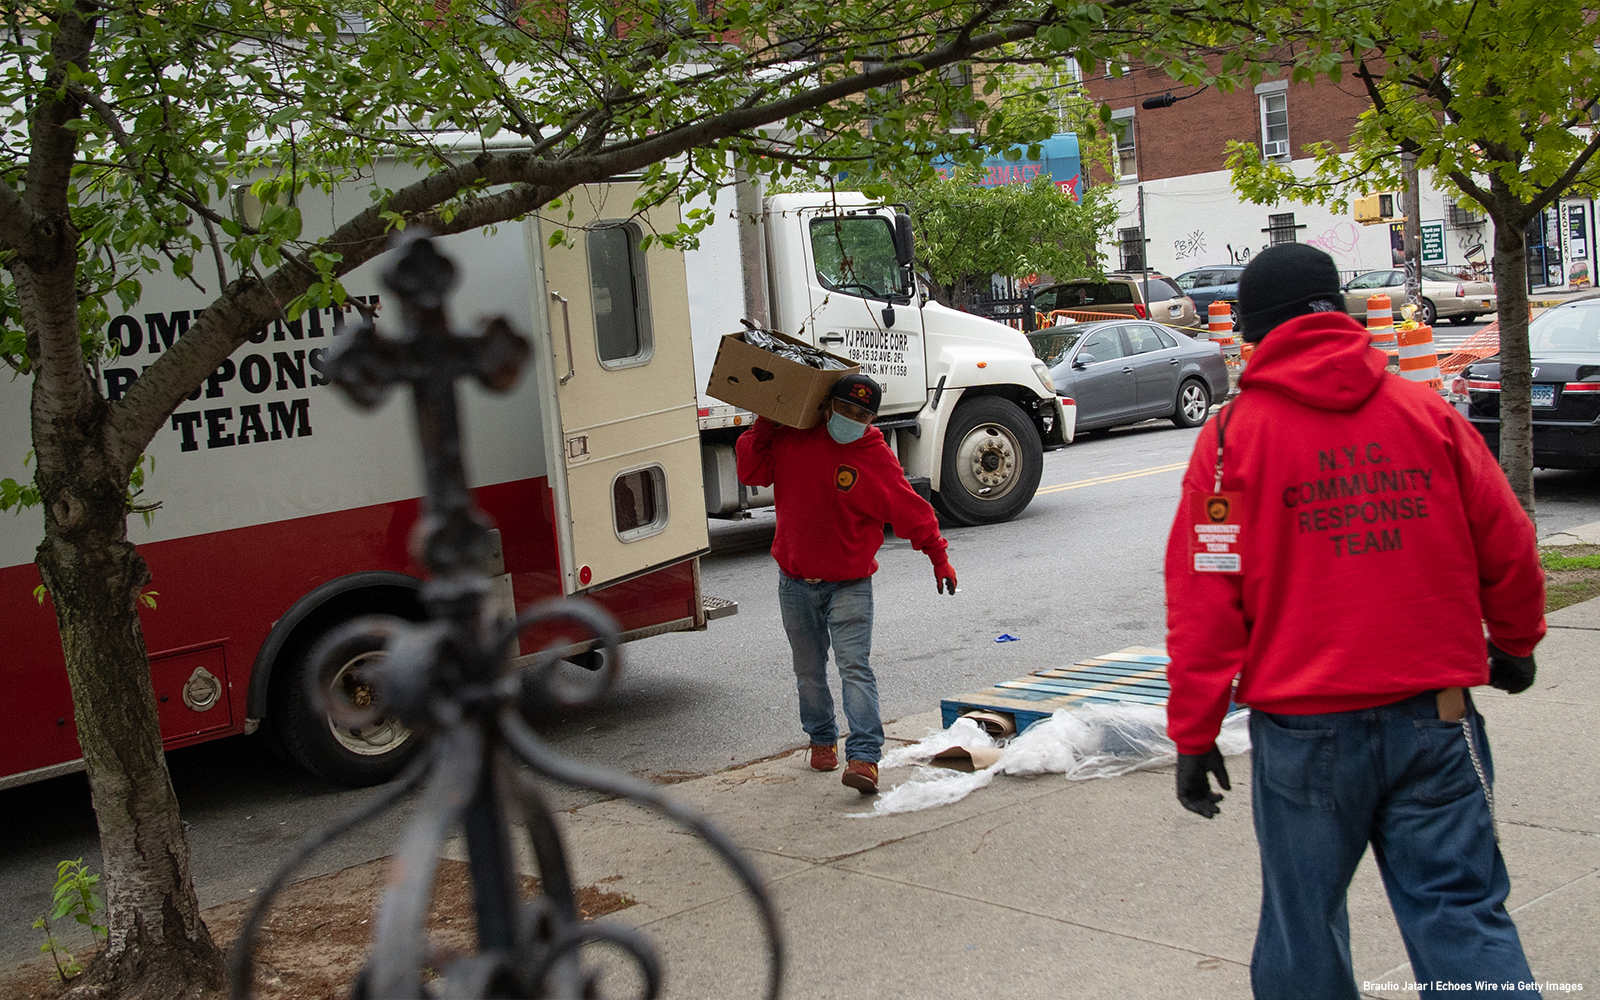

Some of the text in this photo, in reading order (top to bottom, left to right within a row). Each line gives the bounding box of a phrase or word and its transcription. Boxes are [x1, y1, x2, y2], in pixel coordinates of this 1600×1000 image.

[1561, 204, 1570, 264] GROCERY
[107, 294, 381, 357] OMNIT
[845, 329, 909, 351] YJ PRODUCE CORP.
[103, 347, 331, 401] RPONS
[849, 348, 870, 361] 198-15
[870, 350, 879, 361] 32
[893, 352, 905, 363] 2FL
[860, 362, 908, 377] HING, NY 11358
[172, 398, 313, 453] TEAM
[1317, 442, 1391, 472] N.Y.C.
[1282, 468, 1433, 508] COMMUNITY
[1298, 496, 1430, 534] RESPONSE
[1329, 528, 1402, 557] TEAM
